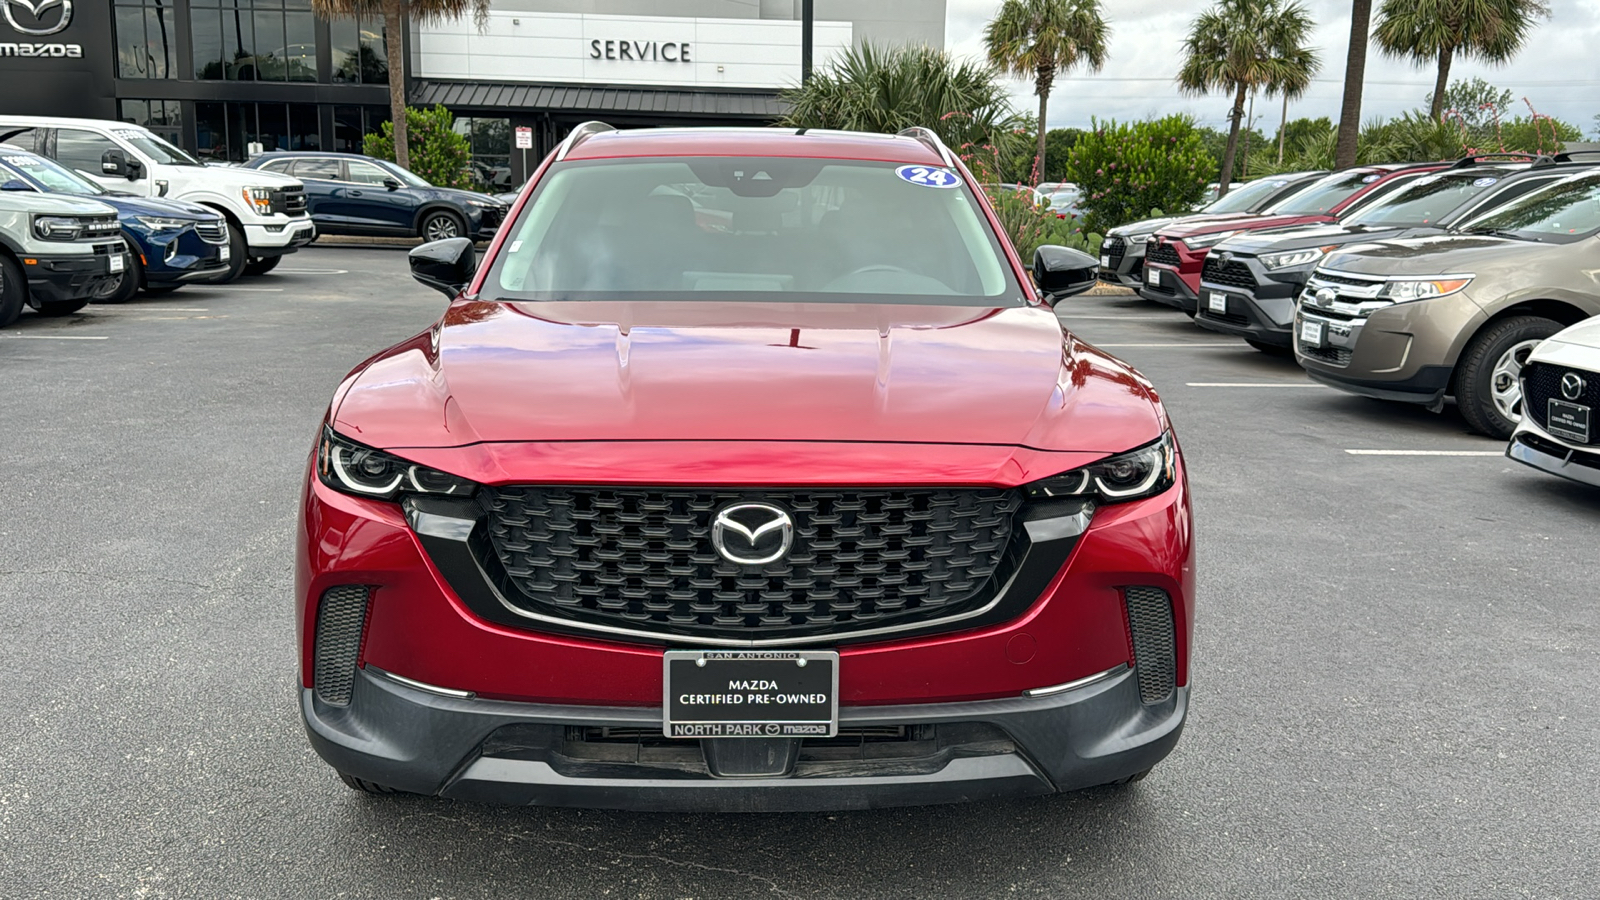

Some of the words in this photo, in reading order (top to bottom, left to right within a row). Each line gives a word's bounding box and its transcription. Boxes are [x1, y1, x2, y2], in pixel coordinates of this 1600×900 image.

[0, 42, 82, 58] mazda
[589, 39, 691, 63] SERVICE
[909, 167, 948, 186] 24
[728, 680, 778, 690] MAZDA
[679, 694, 744, 705] CERTIFIED
[747, 693, 827, 704] PRE-OWNED
[674, 725, 722, 736] NORTH
[726, 724, 762, 735] PARK
